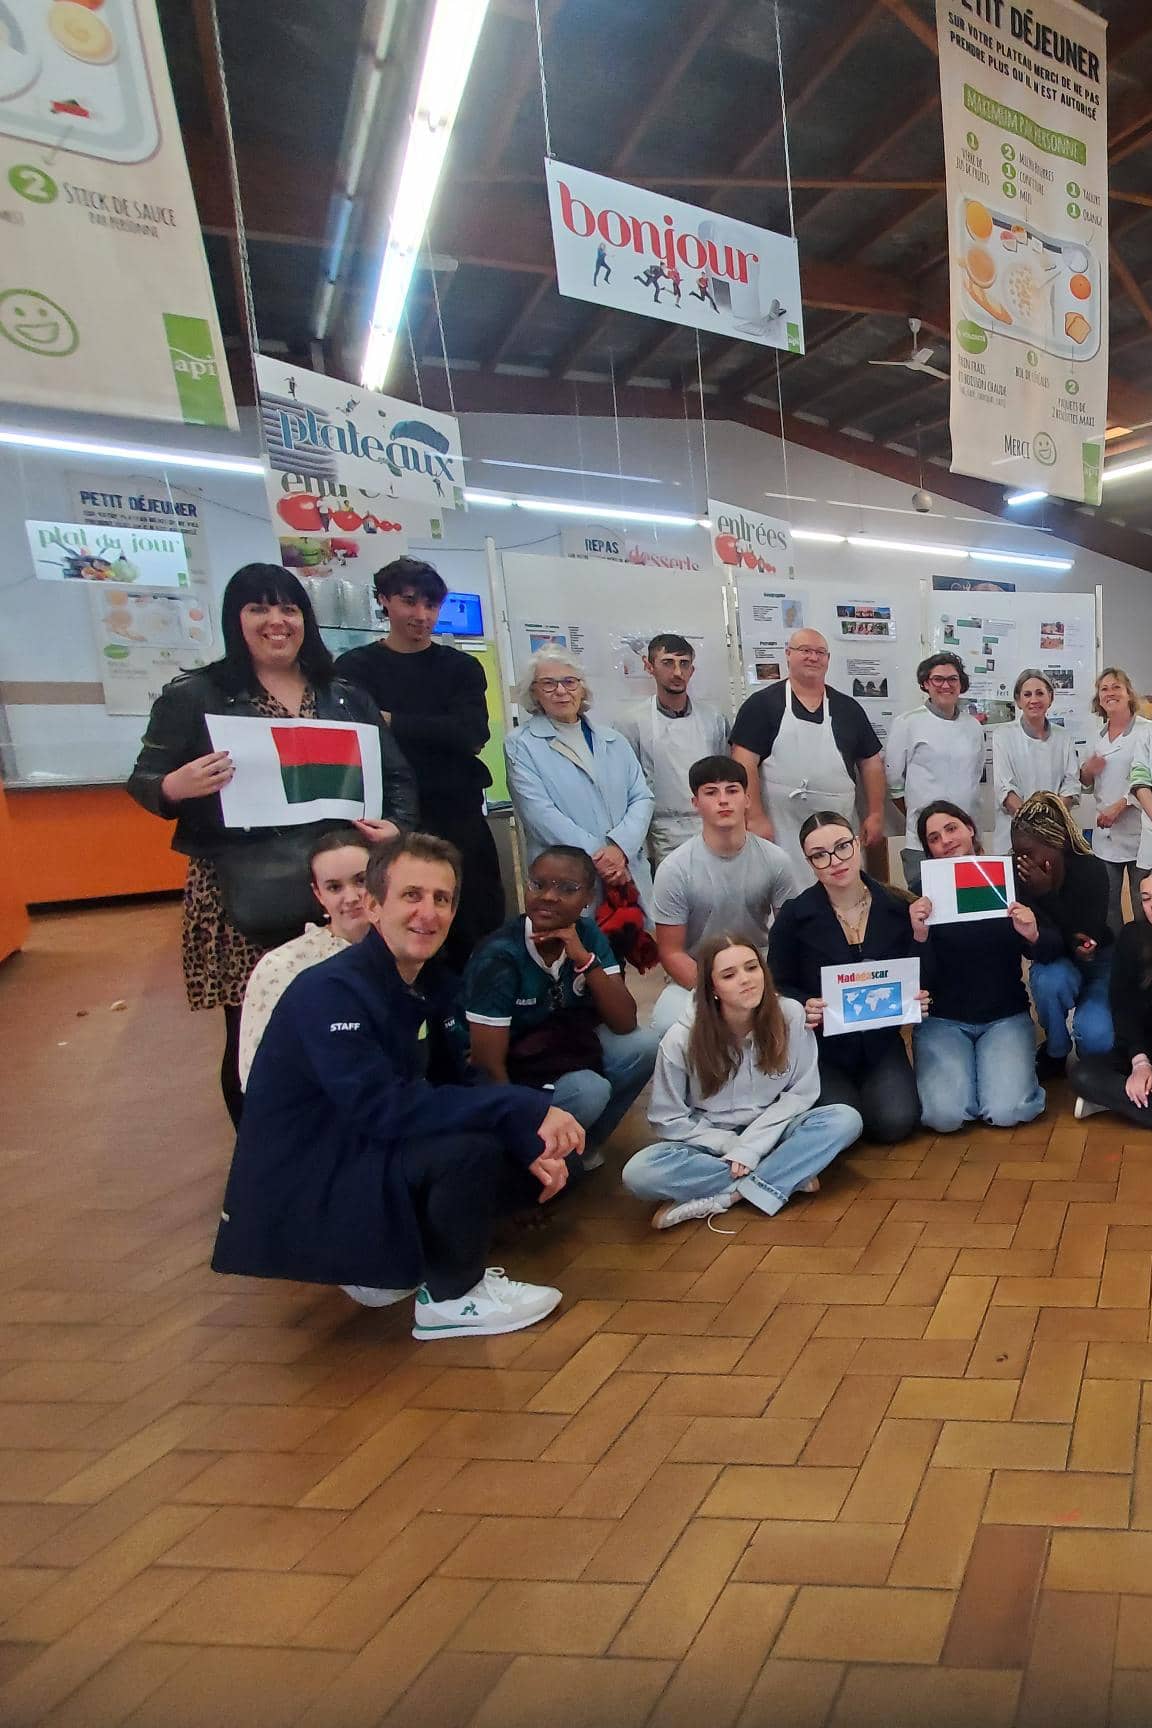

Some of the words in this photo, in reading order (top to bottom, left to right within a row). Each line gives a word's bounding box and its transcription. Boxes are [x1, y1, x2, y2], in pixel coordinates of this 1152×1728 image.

[948, 12, 965, 31] SUR
[967, 22, 993, 50] VOTRE
[996, 40, 1032, 71] PLATEAU
[1033, 63, 1059, 85] MERCI
[1061, 75, 1072, 91] DE
[1073, 82, 1083, 97] NE
[1085, 88, 1100, 106] PAS
[1010, 7, 1100, 83] DÉJEUNER
[950, 31, 986, 64] PRENDRE
[988, 55, 1010, 76] PLUS
[1060, 93, 1097, 121] AUTORISÉ
[20, 169, 49, 197] 2
[62, 182, 114, 213] STICK
[112, 196, 133, 218] DE
[134, 200, 177, 227] SAUCE
[557, 181, 759, 284] bonjour
[174, 354, 217, 381] api
[277, 408, 456, 481] plateaux
[80, 490, 123, 509] PETIT
[129, 494, 198, 518] DÉJEUNER
[717, 514, 788, 550] entrées
[38, 526, 88, 548] plat
[131, 533, 180, 553] jour
[330, 1022, 361, 1032] STAFF
